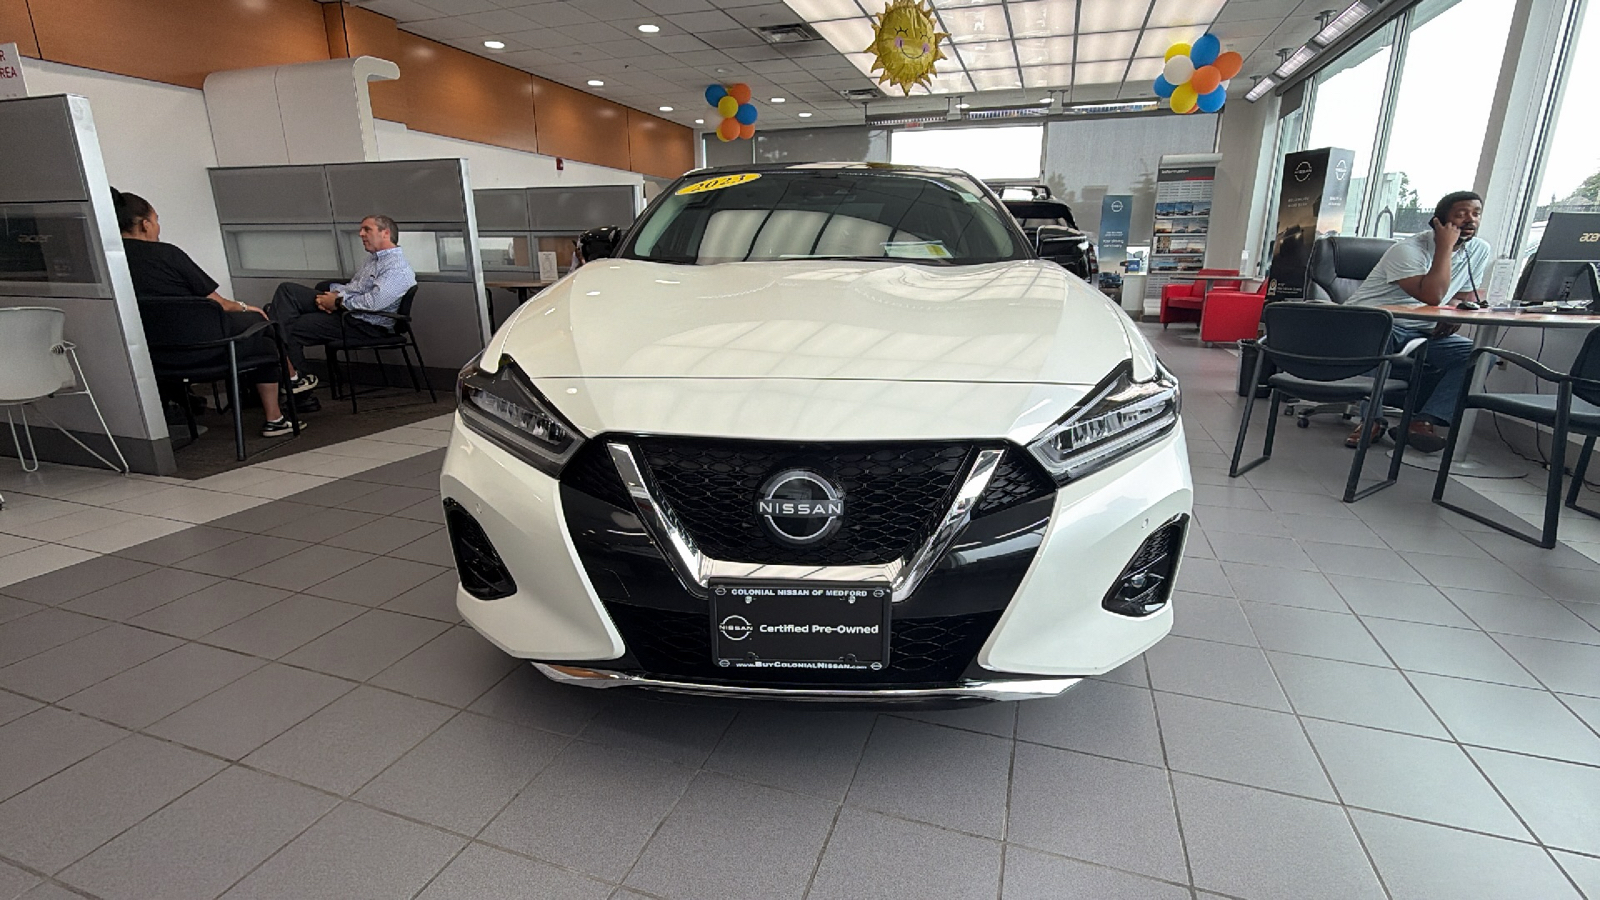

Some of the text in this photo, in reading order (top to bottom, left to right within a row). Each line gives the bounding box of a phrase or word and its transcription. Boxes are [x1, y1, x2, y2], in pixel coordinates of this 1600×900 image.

[690, 175, 746, 192] 2023
[759, 501, 841, 515] NISSAN
[731, 588, 775, 596] COLONIAL
[777, 589, 810, 597] NISSAN
[825, 589, 868, 597] MEDFORD
[759, 624, 879, 634] Certified Pre-Owned
